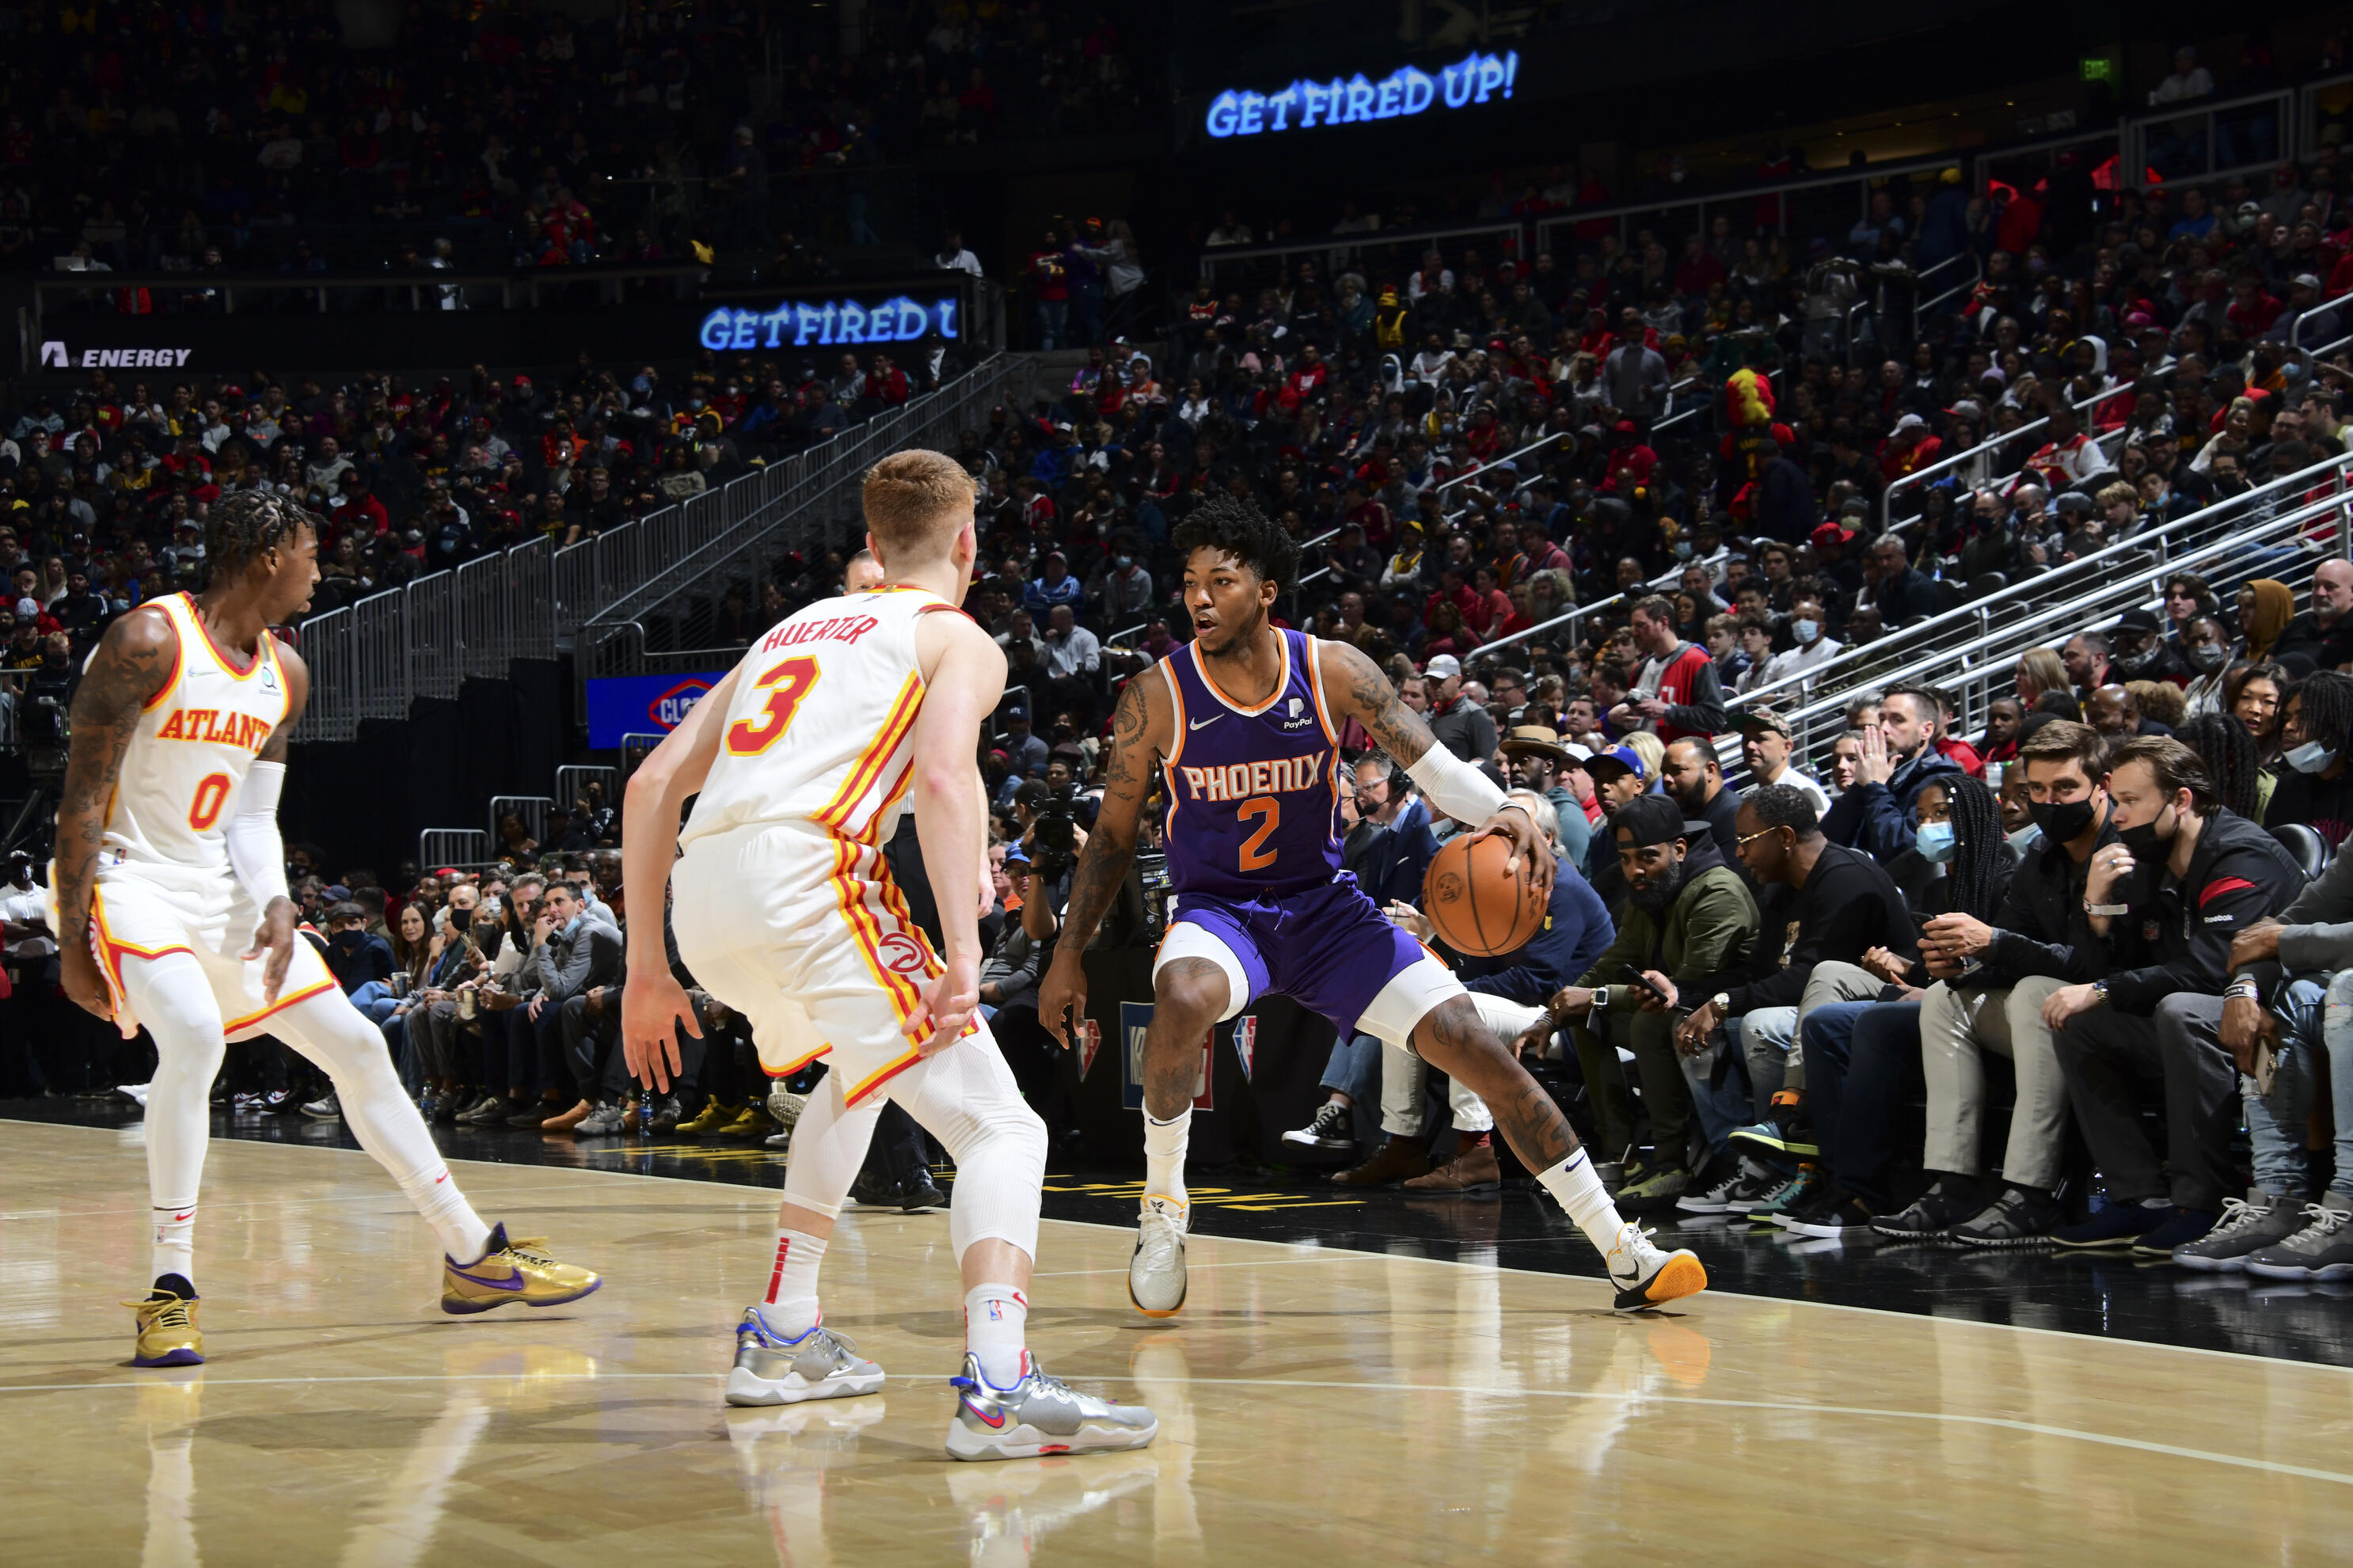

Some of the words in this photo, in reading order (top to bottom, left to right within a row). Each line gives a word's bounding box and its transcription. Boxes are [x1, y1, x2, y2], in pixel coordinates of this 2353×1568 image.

[1207, 89, 1297, 138] GET
[1299, 65, 1435, 128] FIRED
[1443, 50, 1519, 108] UP!
[701, 304, 790, 350] GET
[793, 296, 929, 345] FIRED
[82, 348, 192, 367] ENERGY
[762, 614, 879, 654] HUERTER
[724, 654, 822, 757] 3
[1283, 717, 1313, 729] PayPal
[156, 708, 272, 756] ATLANT
[1180, 750, 1327, 802] PHOENIX
[188, 773, 232, 832] 0
[1237, 795, 1280, 872] 2
[2203, 914, 2233, 924] Reebok
